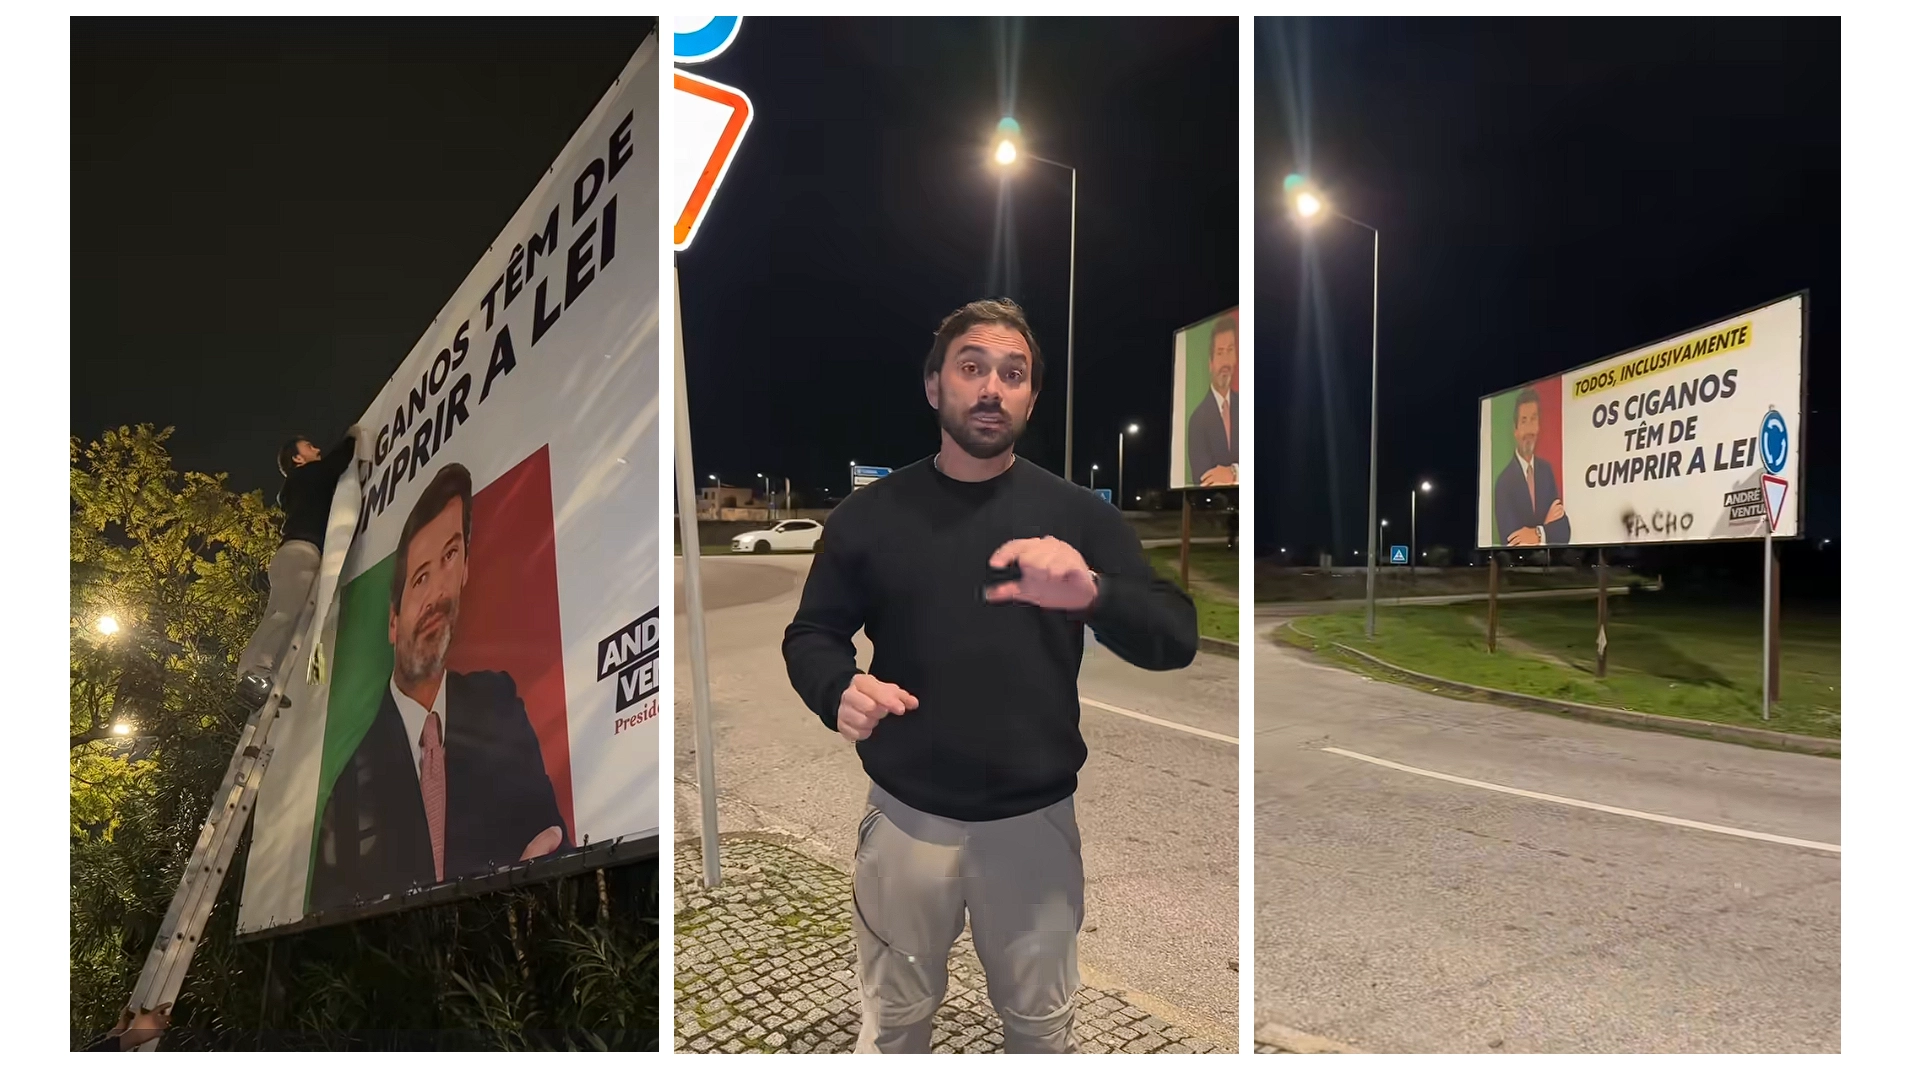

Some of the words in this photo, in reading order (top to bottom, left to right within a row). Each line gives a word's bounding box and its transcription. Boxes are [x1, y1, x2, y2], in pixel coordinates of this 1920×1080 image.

[480, 203, 560, 332] TÊM
[572, 108, 634, 228] DE
[478, 323, 516, 406] A
[531, 193, 617, 348] LEI
[1575, 370, 1617, 397] TODOS,
[1620, 326, 1748, 381] INCLUSIVAMENTE
[1592, 400, 1620, 428] OS
[1624, 369, 1738, 421] CIGANOS
[1585, 450, 1682, 488] CUMPRIR
[1686, 446, 1706, 475] A
[1713, 437, 1757, 472] LEI
[1624, 420, 1664, 452] TÊM
[1668, 415, 1698, 444] DE
[614, 698, 659, 735] Presid
